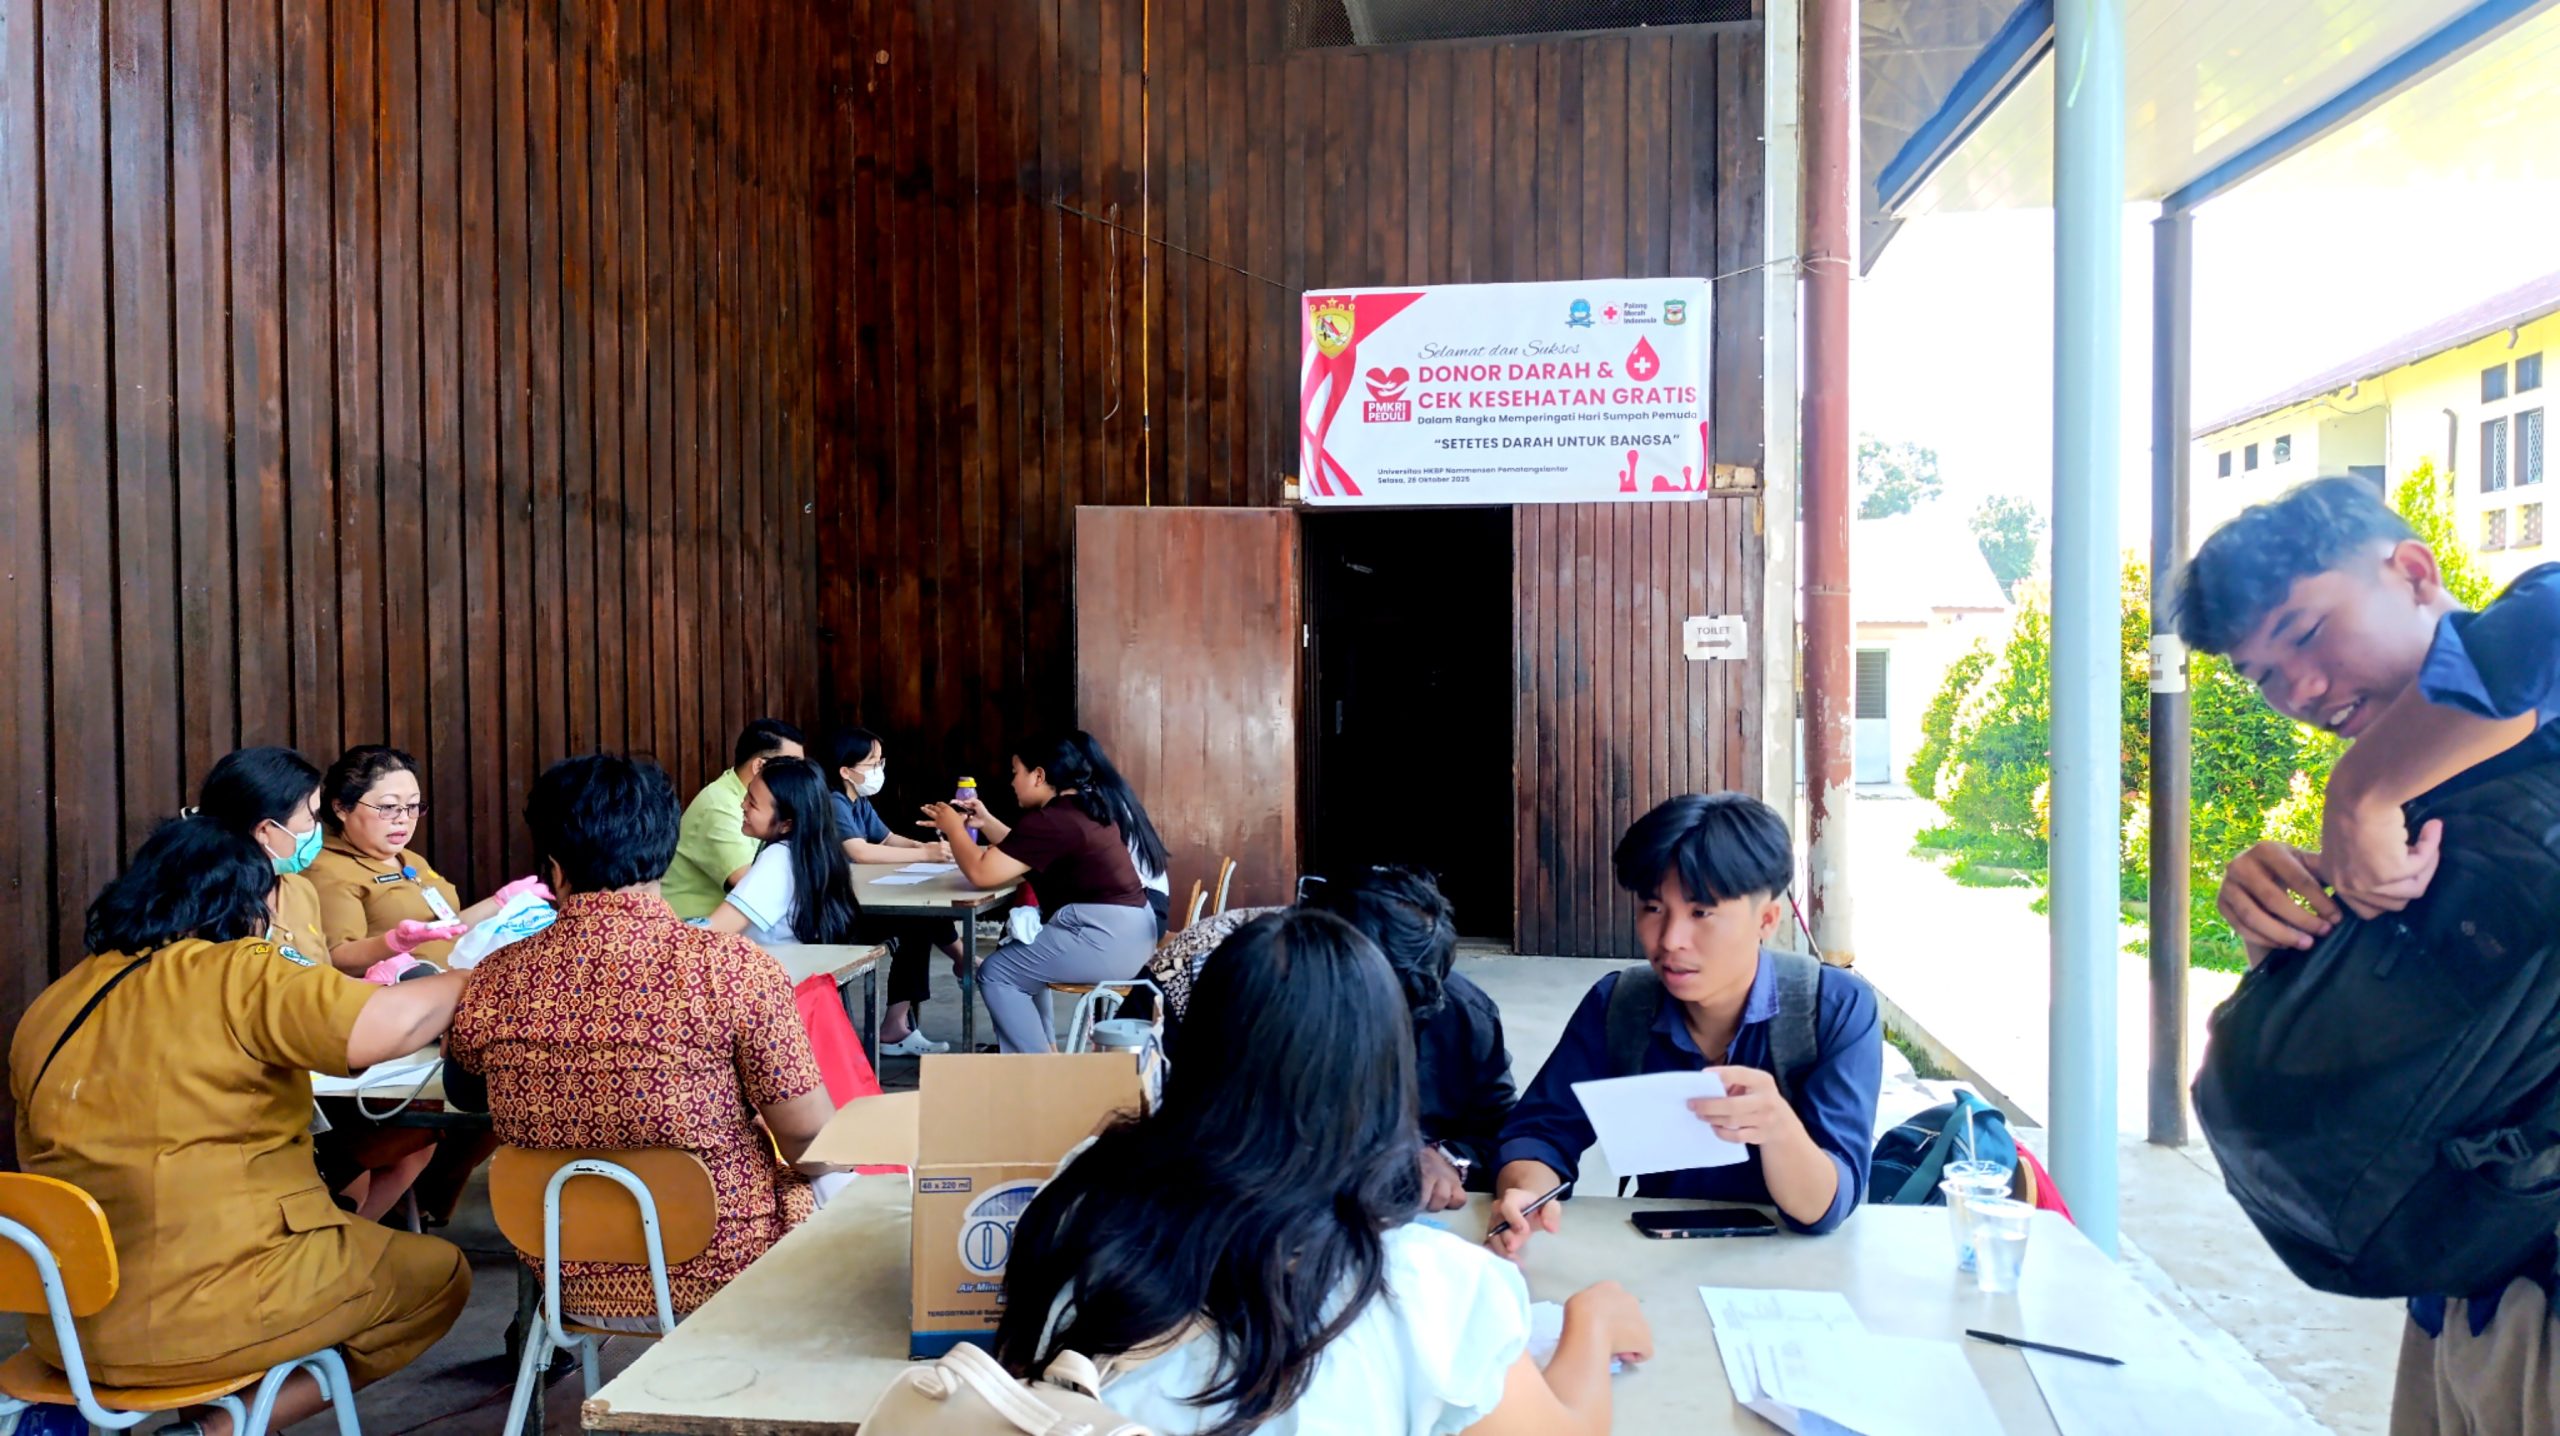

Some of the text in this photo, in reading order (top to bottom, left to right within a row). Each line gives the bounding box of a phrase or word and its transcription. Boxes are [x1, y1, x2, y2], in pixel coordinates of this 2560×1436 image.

[1623, 302, 1648, 310] Palang
[1417, 339, 1580, 360] Selamat dan Sukses
[1418, 361, 1614, 383] DONOR DARAH &
[1418, 386, 1697, 409] CEK KESEHATAN GRATIS
[1369, 402, 1406, 412] PMKRI
[1369, 412, 1406, 421] PEDULI
[1417, 411, 1697, 426] Dalam Rangka Memperingati Hari Sumpah Pemuda
[1502, 436, 1553, 449] DARAH
[1557, 435, 1605, 447] UNTUK
[1377, 467, 1422, 475] Universitas
[1418, 476, 1450, 484] Oktober
[1697, 626, 1730, 635] TOILET
[958, 1282, 974, 1294] Air
